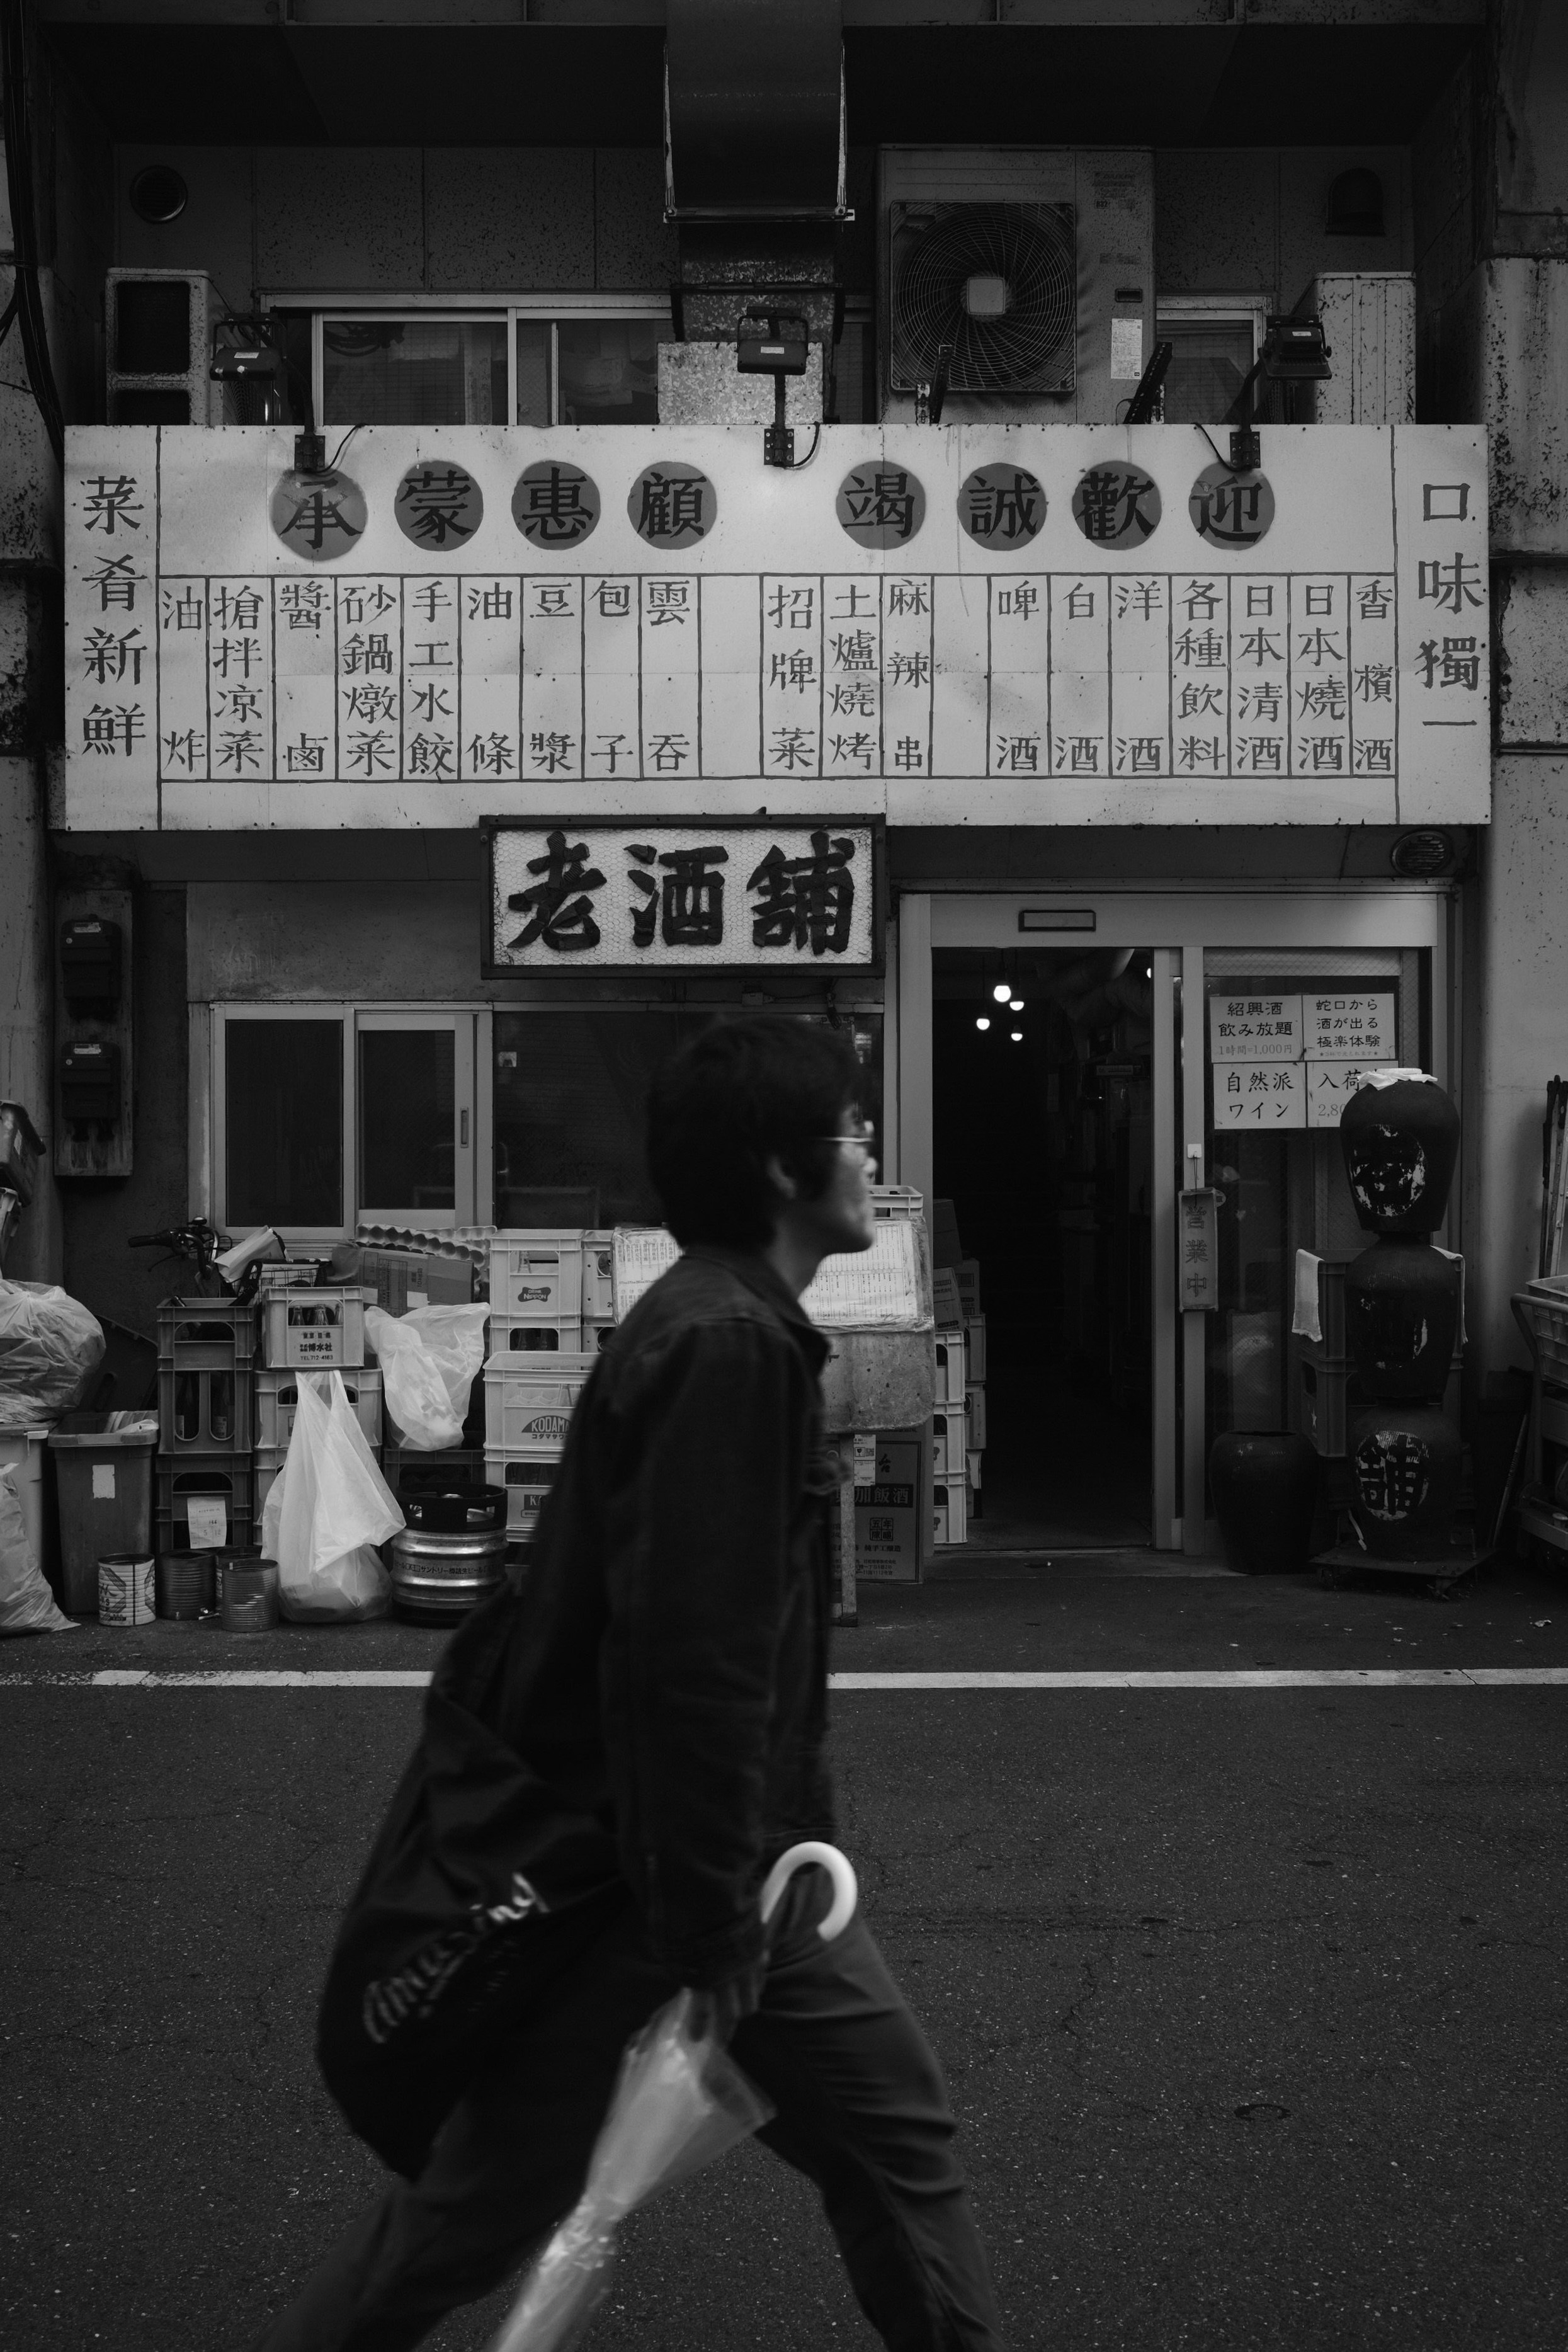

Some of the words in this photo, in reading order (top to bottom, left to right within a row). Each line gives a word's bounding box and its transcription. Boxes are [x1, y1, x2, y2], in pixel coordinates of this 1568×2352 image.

[280, 467, 707, 549] 承蒙惠顧
[843, 471, 1262, 543] 竭誠歡迎
[82, 476, 147, 756] 菜肴新鮮
[162, 586, 205, 773] 油炸
[280, 581, 331, 773] 醬鹵
[338, 584, 398, 776] 砂鍋燉菜
[406, 581, 456, 775] 手工水餃
[466, 582, 516, 775] 油條
[530, 583, 576, 774] 豆漿
[588, 580, 631, 774] 包子
[647, 580, 690, 771] 雲吞
[768, 585, 817, 770] 招牌菜
[827, 585, 878, 770] 土爐燒烤
[887, 579, 929, 771] 麻辣串
[997, 580, 1041, 772] 啤酒
[1054, 583, 1104, 772] 白酒
[1115, 581, 1164, 772] 洋酒
[1174, 579, 1226, 770] 各種飲料
[1236, 585, 1285, 771] 日本清酒
[1295, 585, 1346, 770] 日本燒酒
[1354, 579, 1393, 772] 香檳酒
[1414, 483, 1484, 726] 口味獨一
[1219, 1022, 1293, 1036] 飲み放題
[1227, 1002, 1283, 1017] 紹興酒
[1227, 1072, 1295, 1093] 自然派
[1315, 999, 1378, 1011] 蛇口から
[1316, 1017, 1378, 1029] 酒が出る
[1317, 1035, 1380, 1048] 極楽体験
[1229, 1102, 1289, 1119] ワイン
[1186, 1205, 1208, 1298] 営業中
